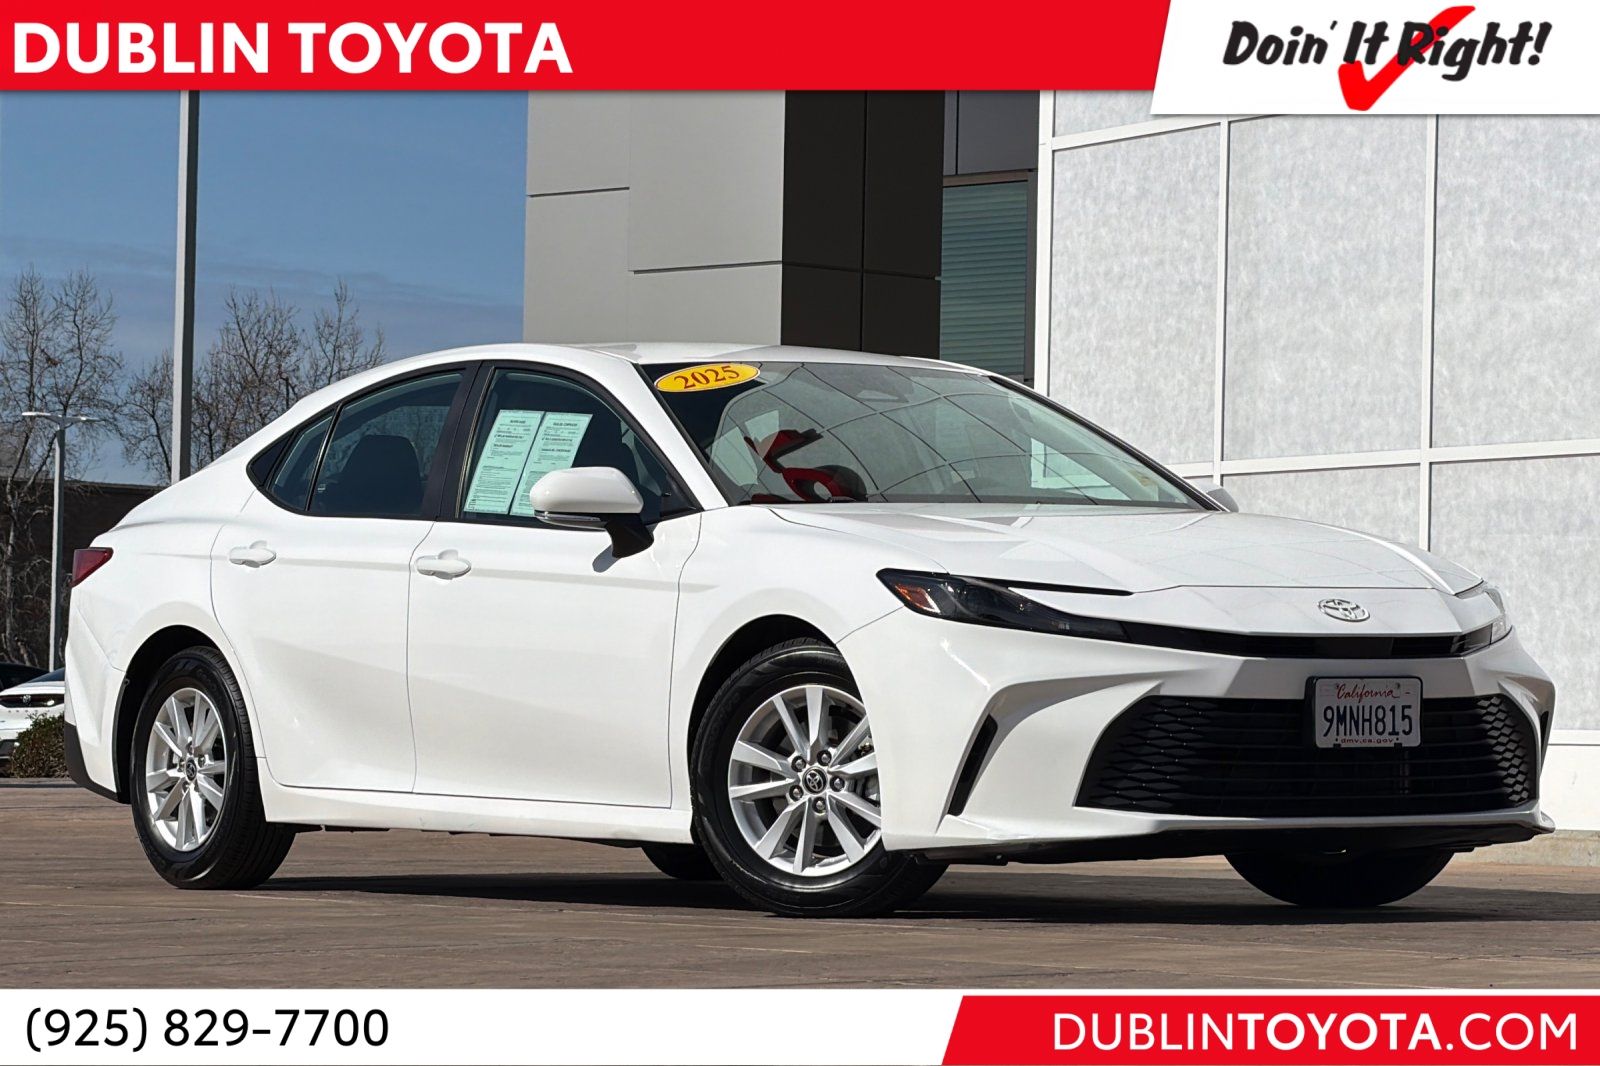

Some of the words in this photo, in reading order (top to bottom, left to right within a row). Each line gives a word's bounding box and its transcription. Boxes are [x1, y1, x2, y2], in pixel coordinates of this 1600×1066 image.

[673, 365, 740, 389] 2025
[1336, 683, 1400, 703] California
[1323, 705, 1413, 737] 9MNH815
